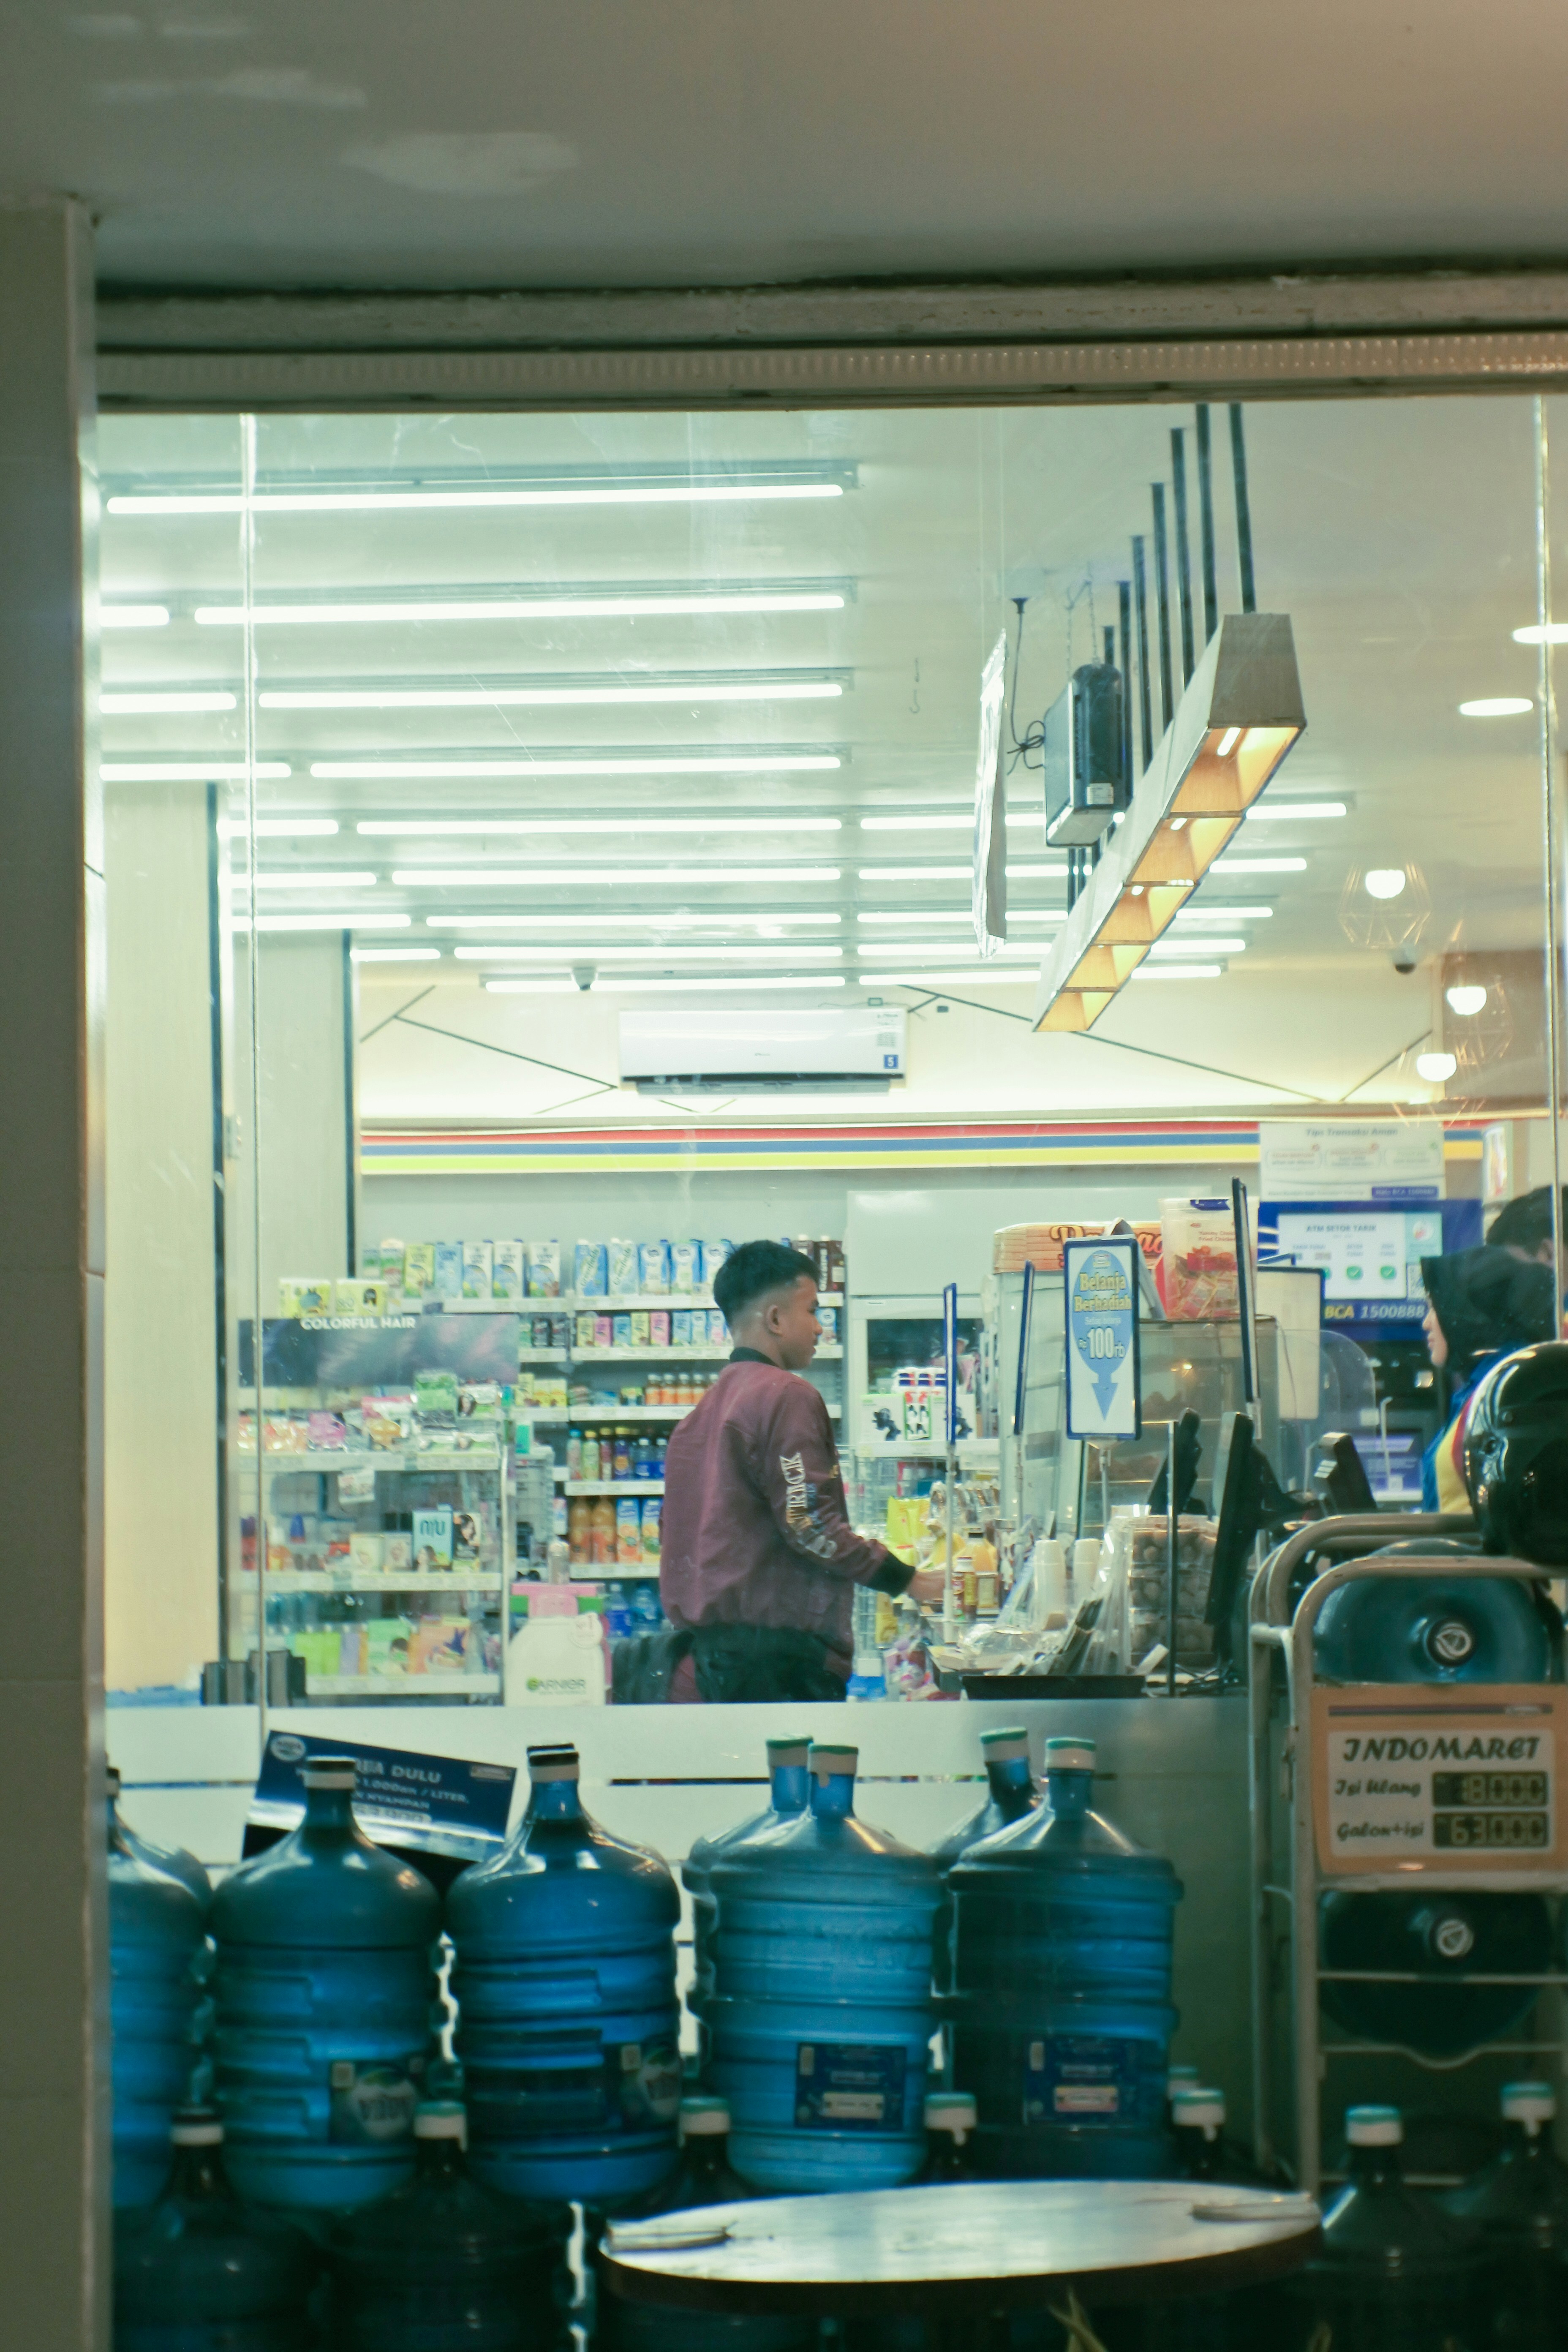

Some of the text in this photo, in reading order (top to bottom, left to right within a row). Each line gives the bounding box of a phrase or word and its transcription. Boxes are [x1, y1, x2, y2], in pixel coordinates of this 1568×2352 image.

[1080, 1271, 1127, 1293] Belanja
[1074, 1294, 1132, 1312] Berhadiah
[1325, 1305, 1426, 1319] BCA 1500888
[300, 1317, 416, 1330] COLORFUL HAIR
[1087, 1327, 1114, 1359] 100
[1343, 1735, 1540, 1761] INDOMARET
[391, 1764, 441, 1783] DULU
[1335, 1779, 1361, 1797] Isi
